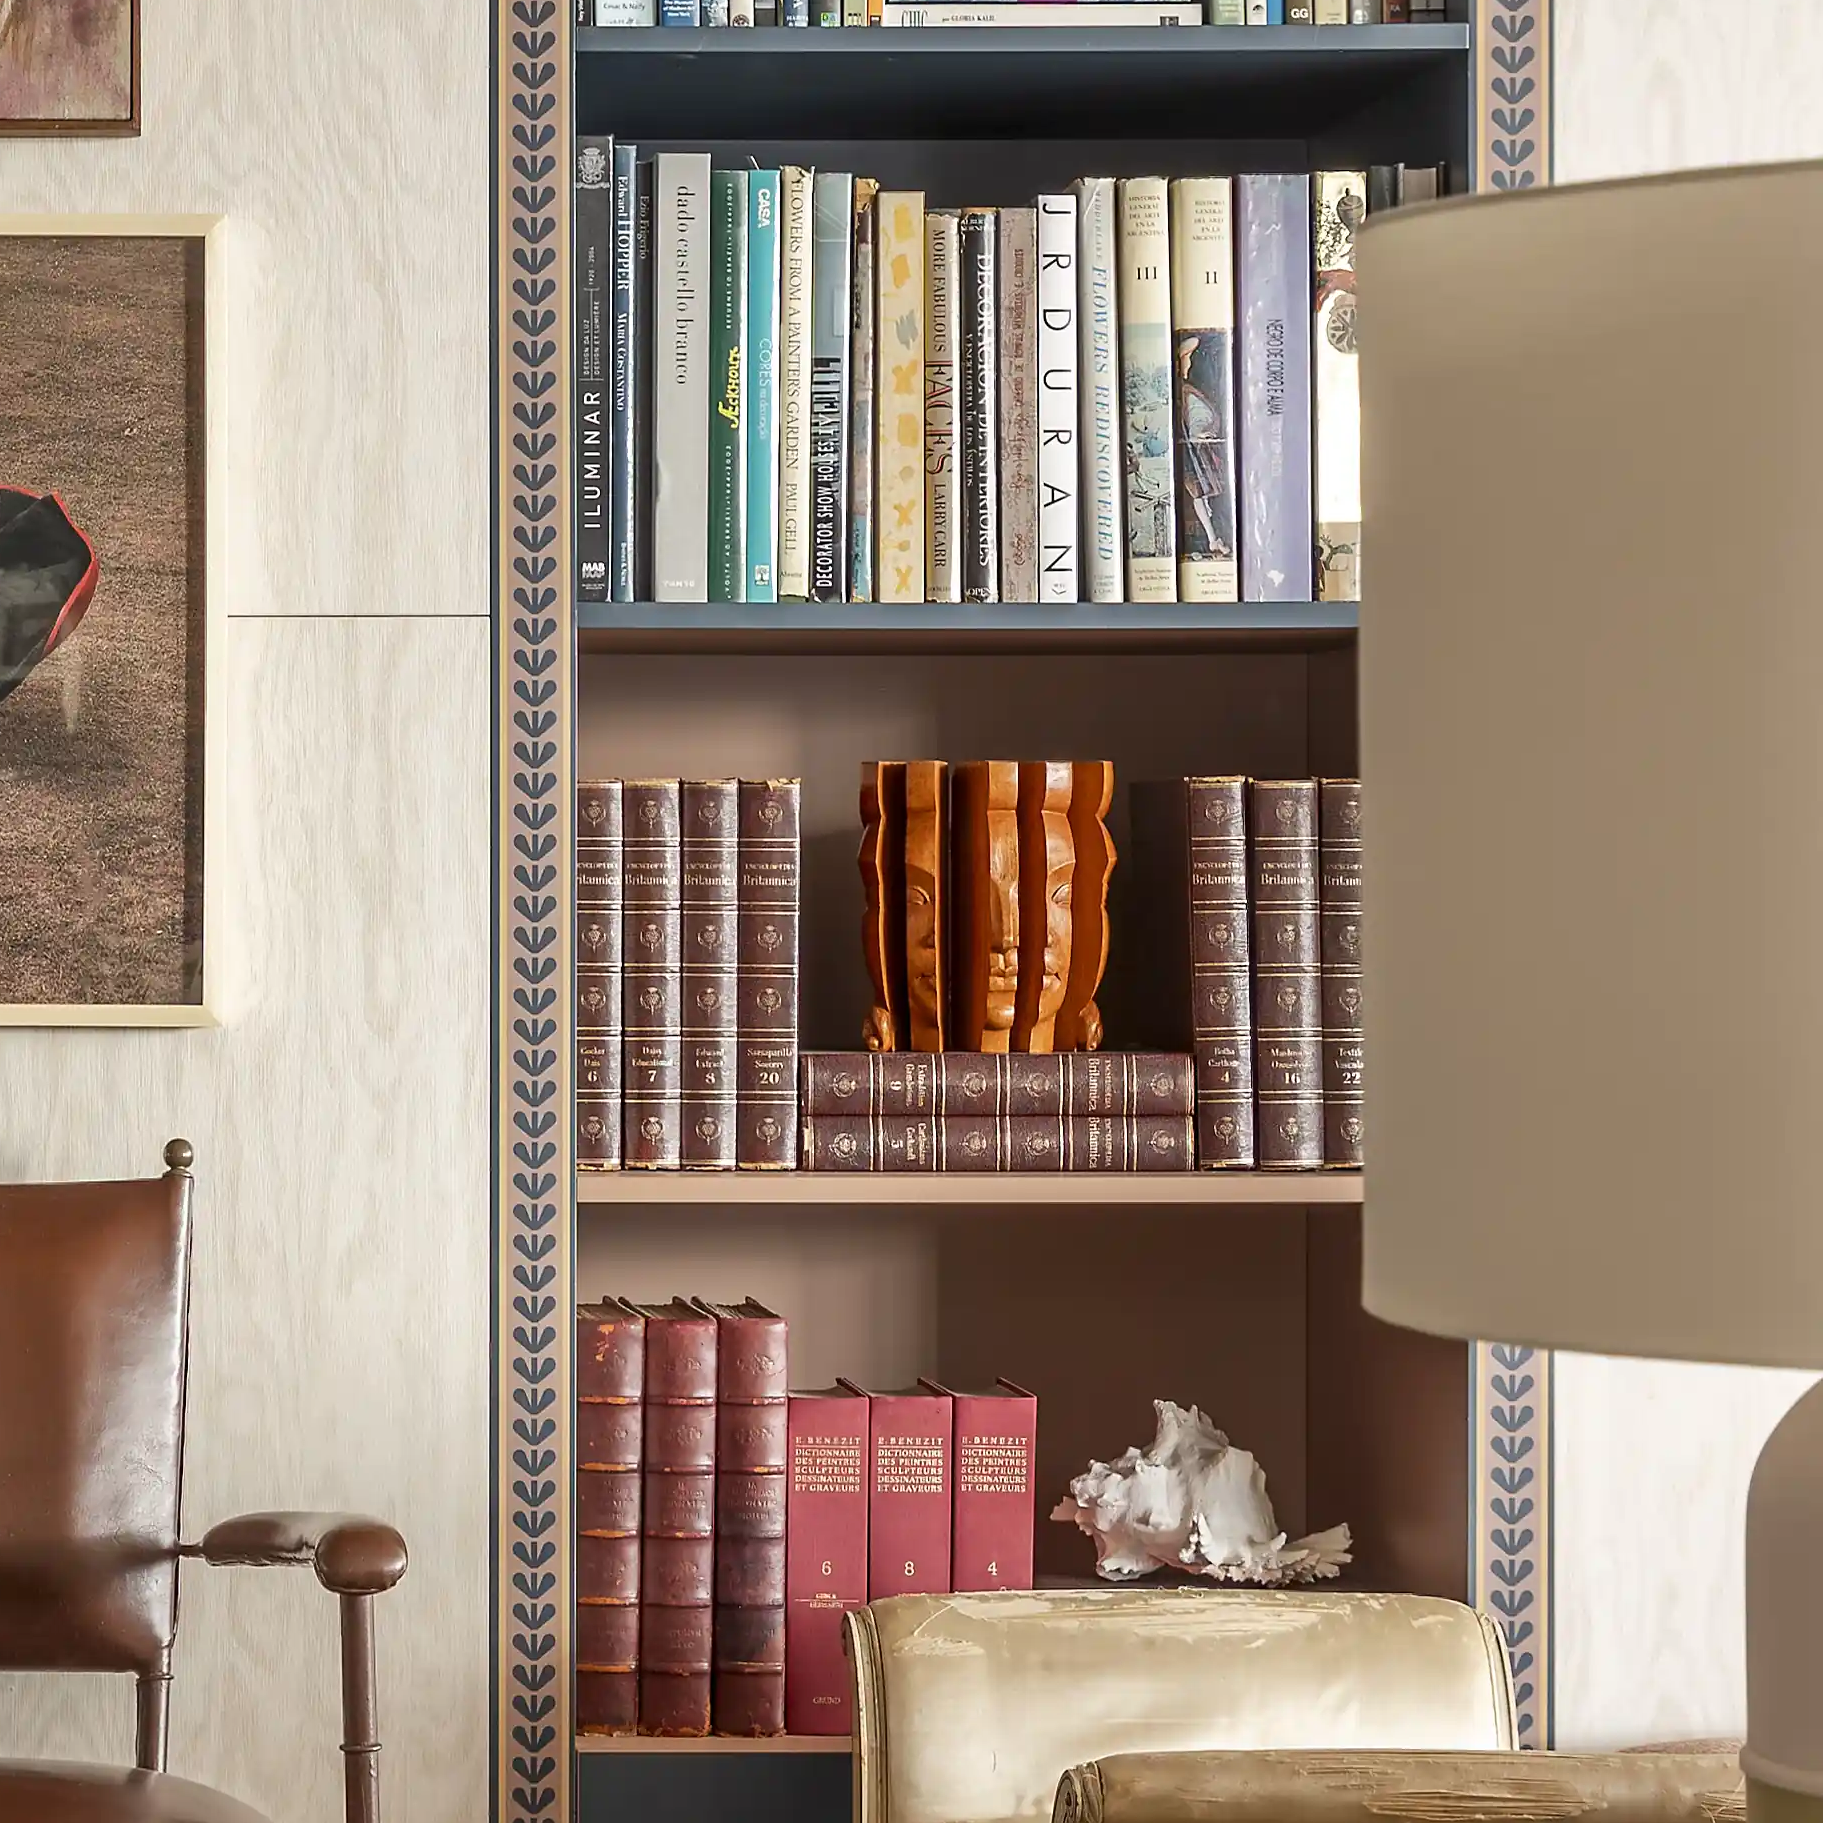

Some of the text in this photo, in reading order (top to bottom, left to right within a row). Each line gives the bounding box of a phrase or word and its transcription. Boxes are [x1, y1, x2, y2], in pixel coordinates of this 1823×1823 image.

[1290, 9, 1309, 19] GG
[616, 176, 631, 291] Edward HOPPER
[676, 186, 694, 385] dado castello branco
[785, 181, 804, 469] FLOWERS FROM A PAINTER'S GARDEN
[926, 230, 954, 568] MORE FABULOUS FACES LARRY CARR
[584, 391, 600, 528] ILUMINAR
[759, 1072, 779, 1084] 20
[890, 1437, 943, 1445] BENEZIT
[878, 1458, 943, 1466] DES PEINTRES
[878, 1467, 943, 1475] SCULPTEURS
[821, 1561, 832, 1576] 6
[904, 1562, 915, 1576] 8
[987, 1562, 998, 1576] 4
